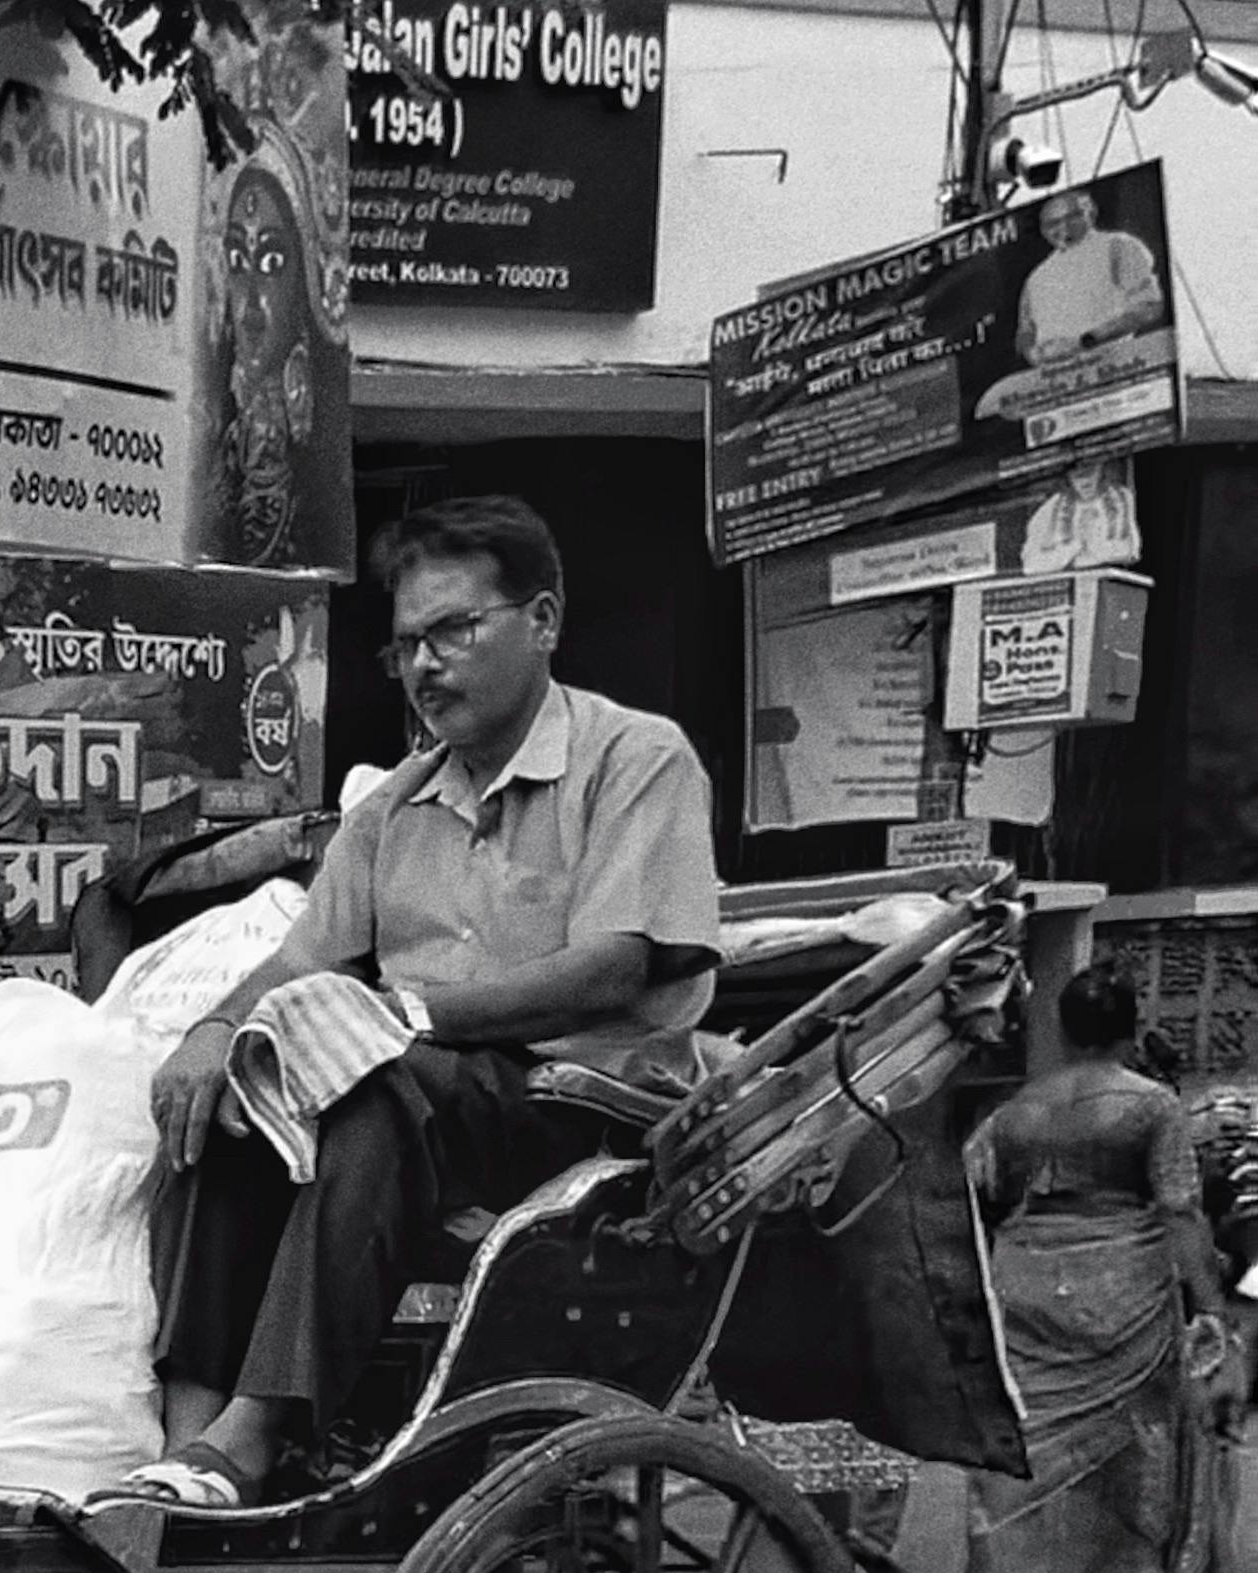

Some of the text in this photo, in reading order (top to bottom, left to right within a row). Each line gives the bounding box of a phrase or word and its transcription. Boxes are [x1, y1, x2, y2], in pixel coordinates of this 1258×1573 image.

[445, 2, 531, 81] Girls'
[542, 9, 661, 109] College
[400, 261, 480, 285] Kolkata
[496, 264, 570, 289] 700073
[714, 285, 828, 349] MISSION
[837, 247, 934, 306] MAGIC
[938, 214, 1020, 268] TEAM
[86, 423, 165, 470] ৭০০০১২
